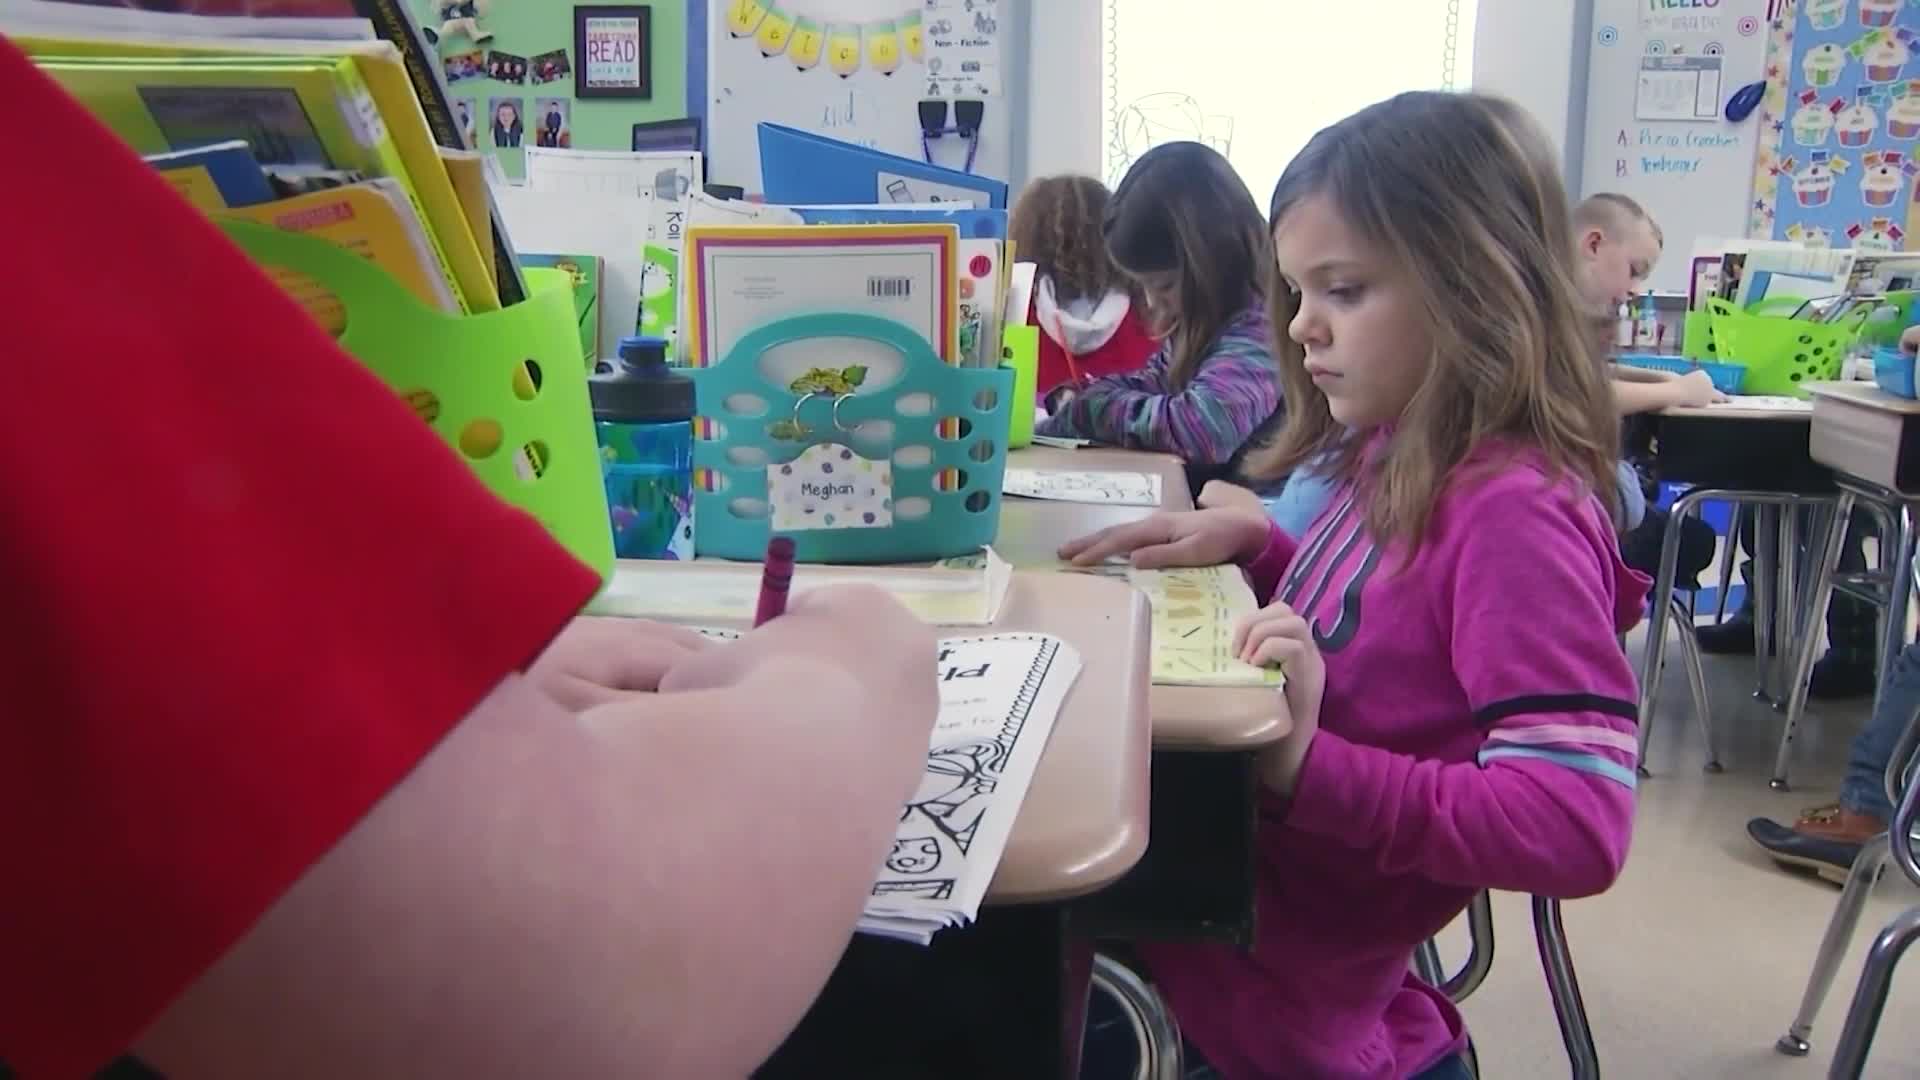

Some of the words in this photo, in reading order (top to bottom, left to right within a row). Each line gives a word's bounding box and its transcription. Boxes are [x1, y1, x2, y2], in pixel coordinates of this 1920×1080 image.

[588, 40, 637, 63] READ
[666, 211, 683, 240] Roll
[801, 482, 855, 501] Meghan
